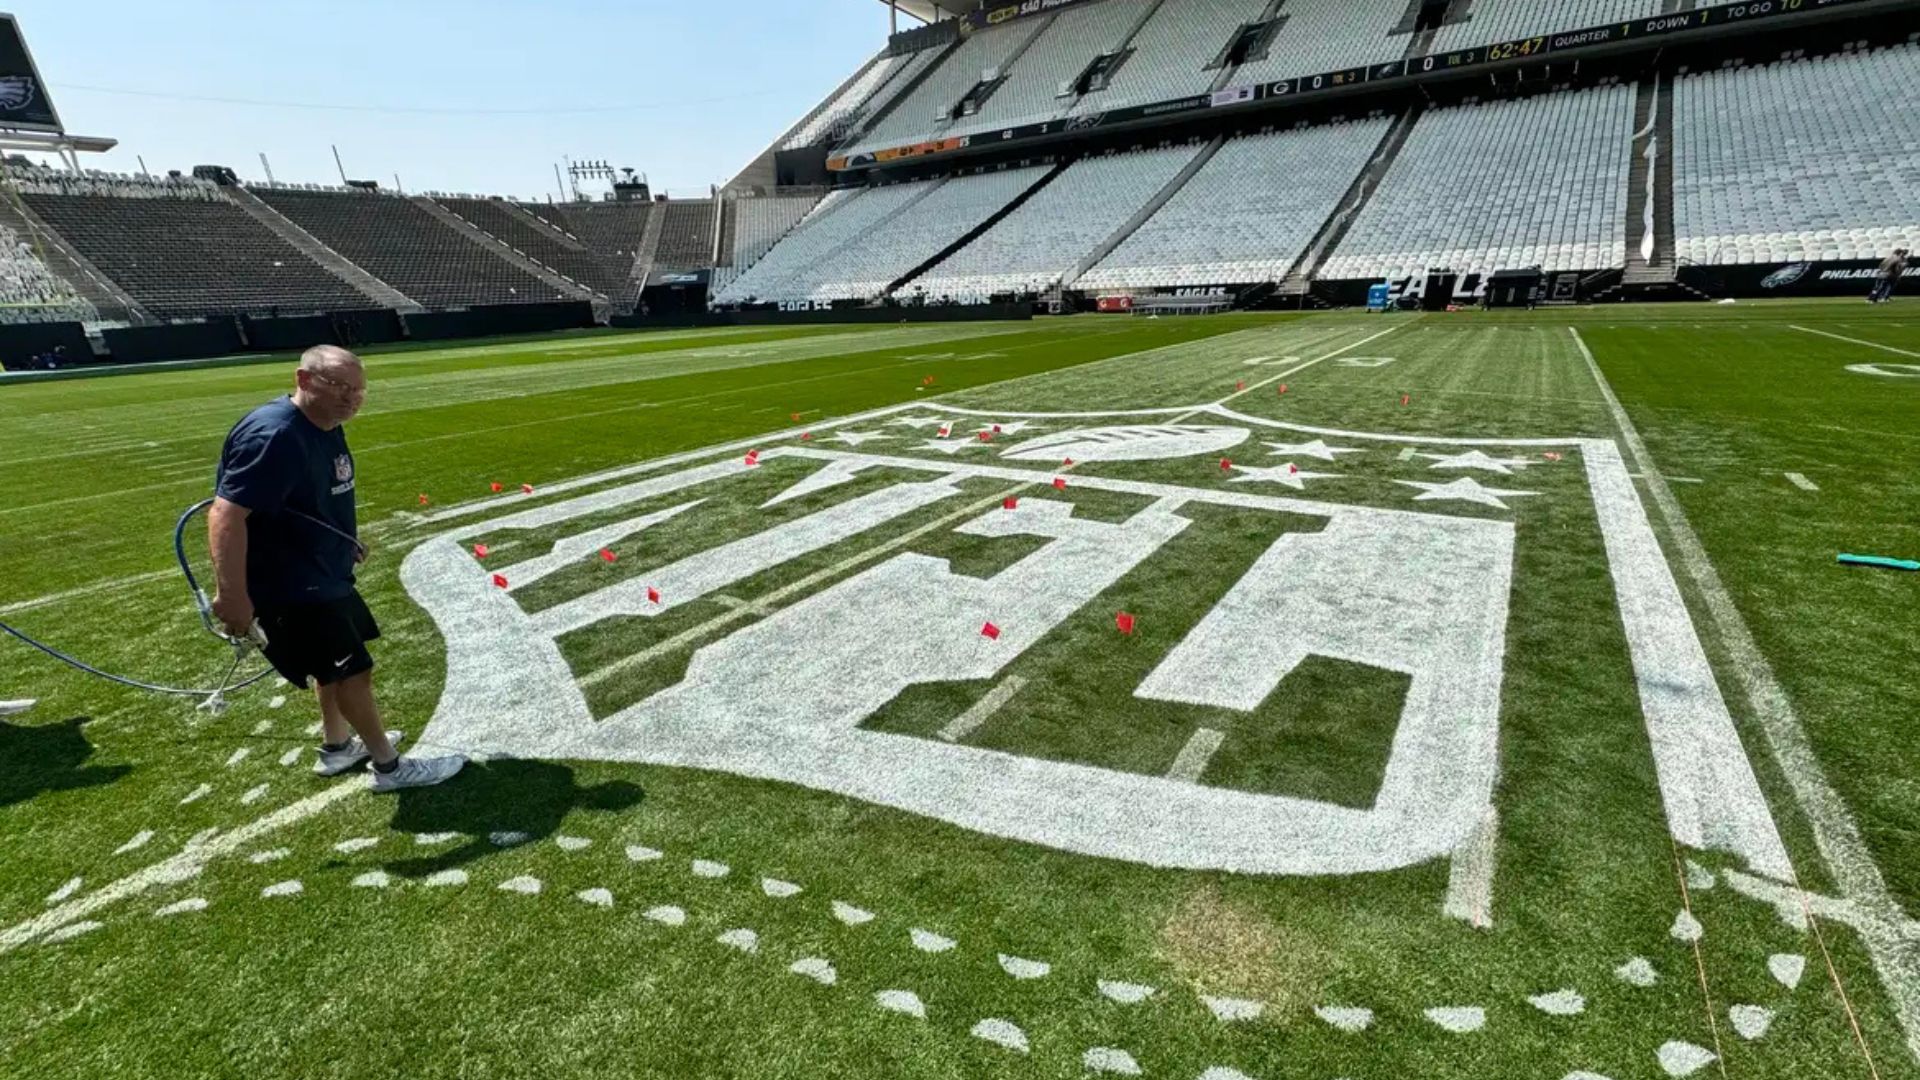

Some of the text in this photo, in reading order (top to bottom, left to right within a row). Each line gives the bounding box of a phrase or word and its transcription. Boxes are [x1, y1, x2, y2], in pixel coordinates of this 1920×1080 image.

[1312, 76, 1322, 89] 0
[1423, 58, 1434, 71] 0
[1466, 52, 1475, 63] 3
[1489, 37, 1543, 60] 62:47
[1554, 29, 1610, 48] QUARTER
[1621, 24, 1630, 37] 1
[1646, 15, 1690, 32] DOWN
[1699, 11, 1709, 24] 1
[1726, 7, 1745, 19] TO
[1749, 2, 1772, 15] GO
[1780, 0, 1801, 10] 10
[1819, 266, 1920, 280] PHILADEIA
